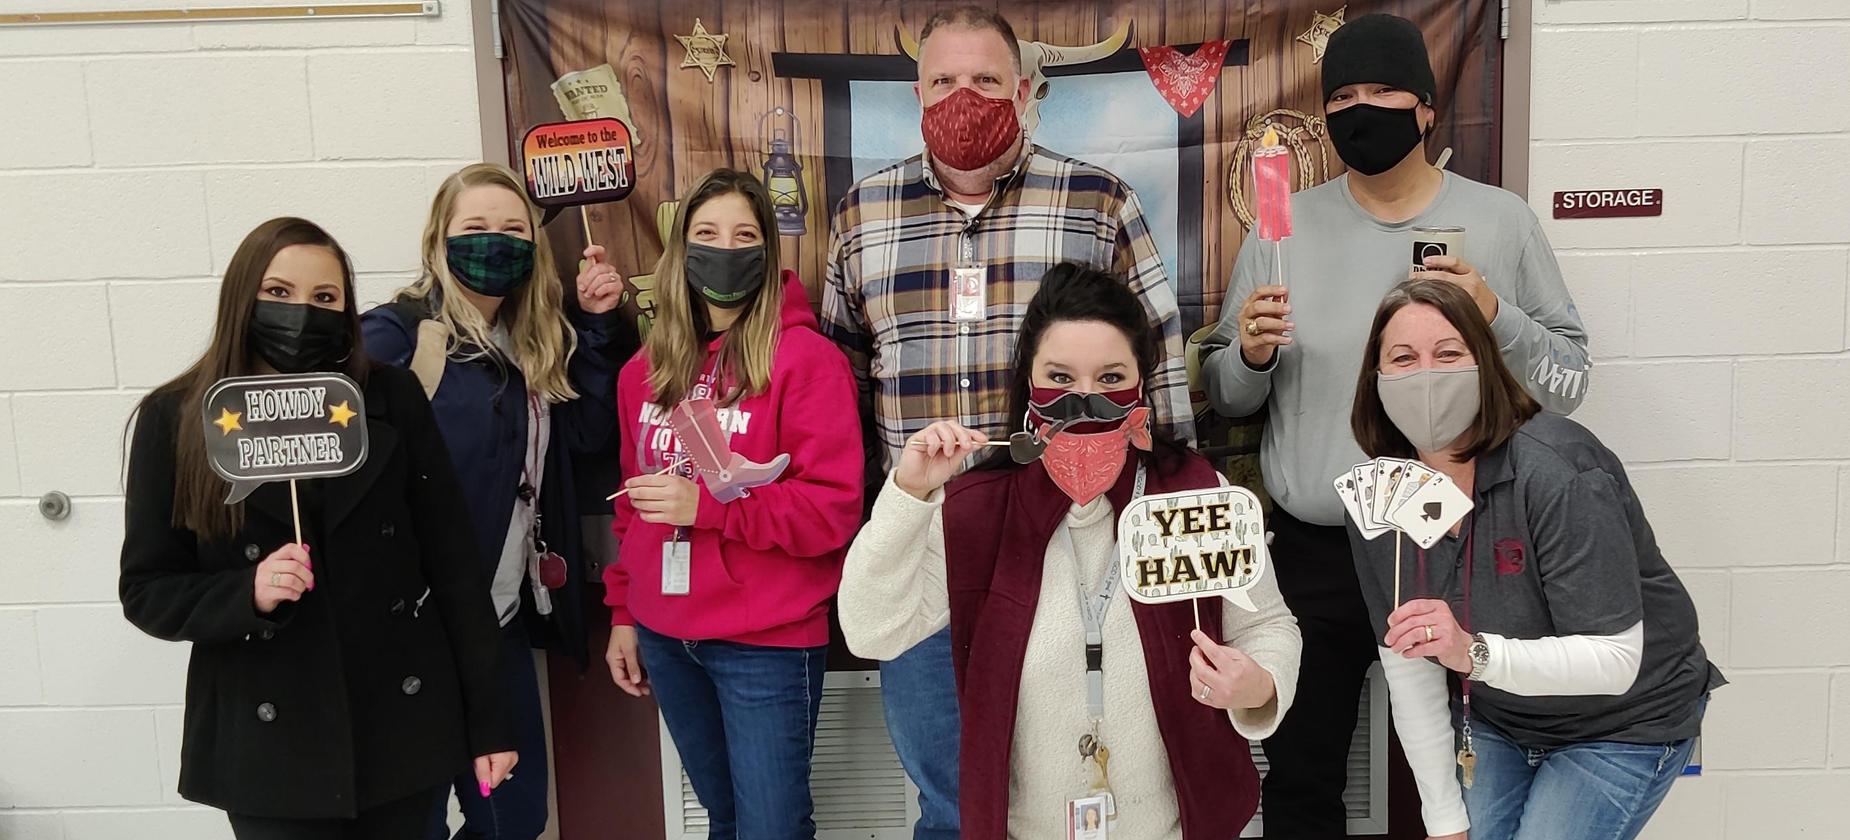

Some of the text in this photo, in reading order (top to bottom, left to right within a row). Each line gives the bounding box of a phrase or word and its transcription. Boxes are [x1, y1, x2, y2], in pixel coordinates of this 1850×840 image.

[536, 127, 617, 148] Welcome to the
[531, 146, 628, 198] WILD WEST
[1562, 190, 1654, 209] STORAGE
[245, 387, 326, 422] HOWDY
[238, 432, 343, 470] PARTNER
[1152, 504, 1231, 537] YEE
[1136, 548, 1252, 587] HAW!
